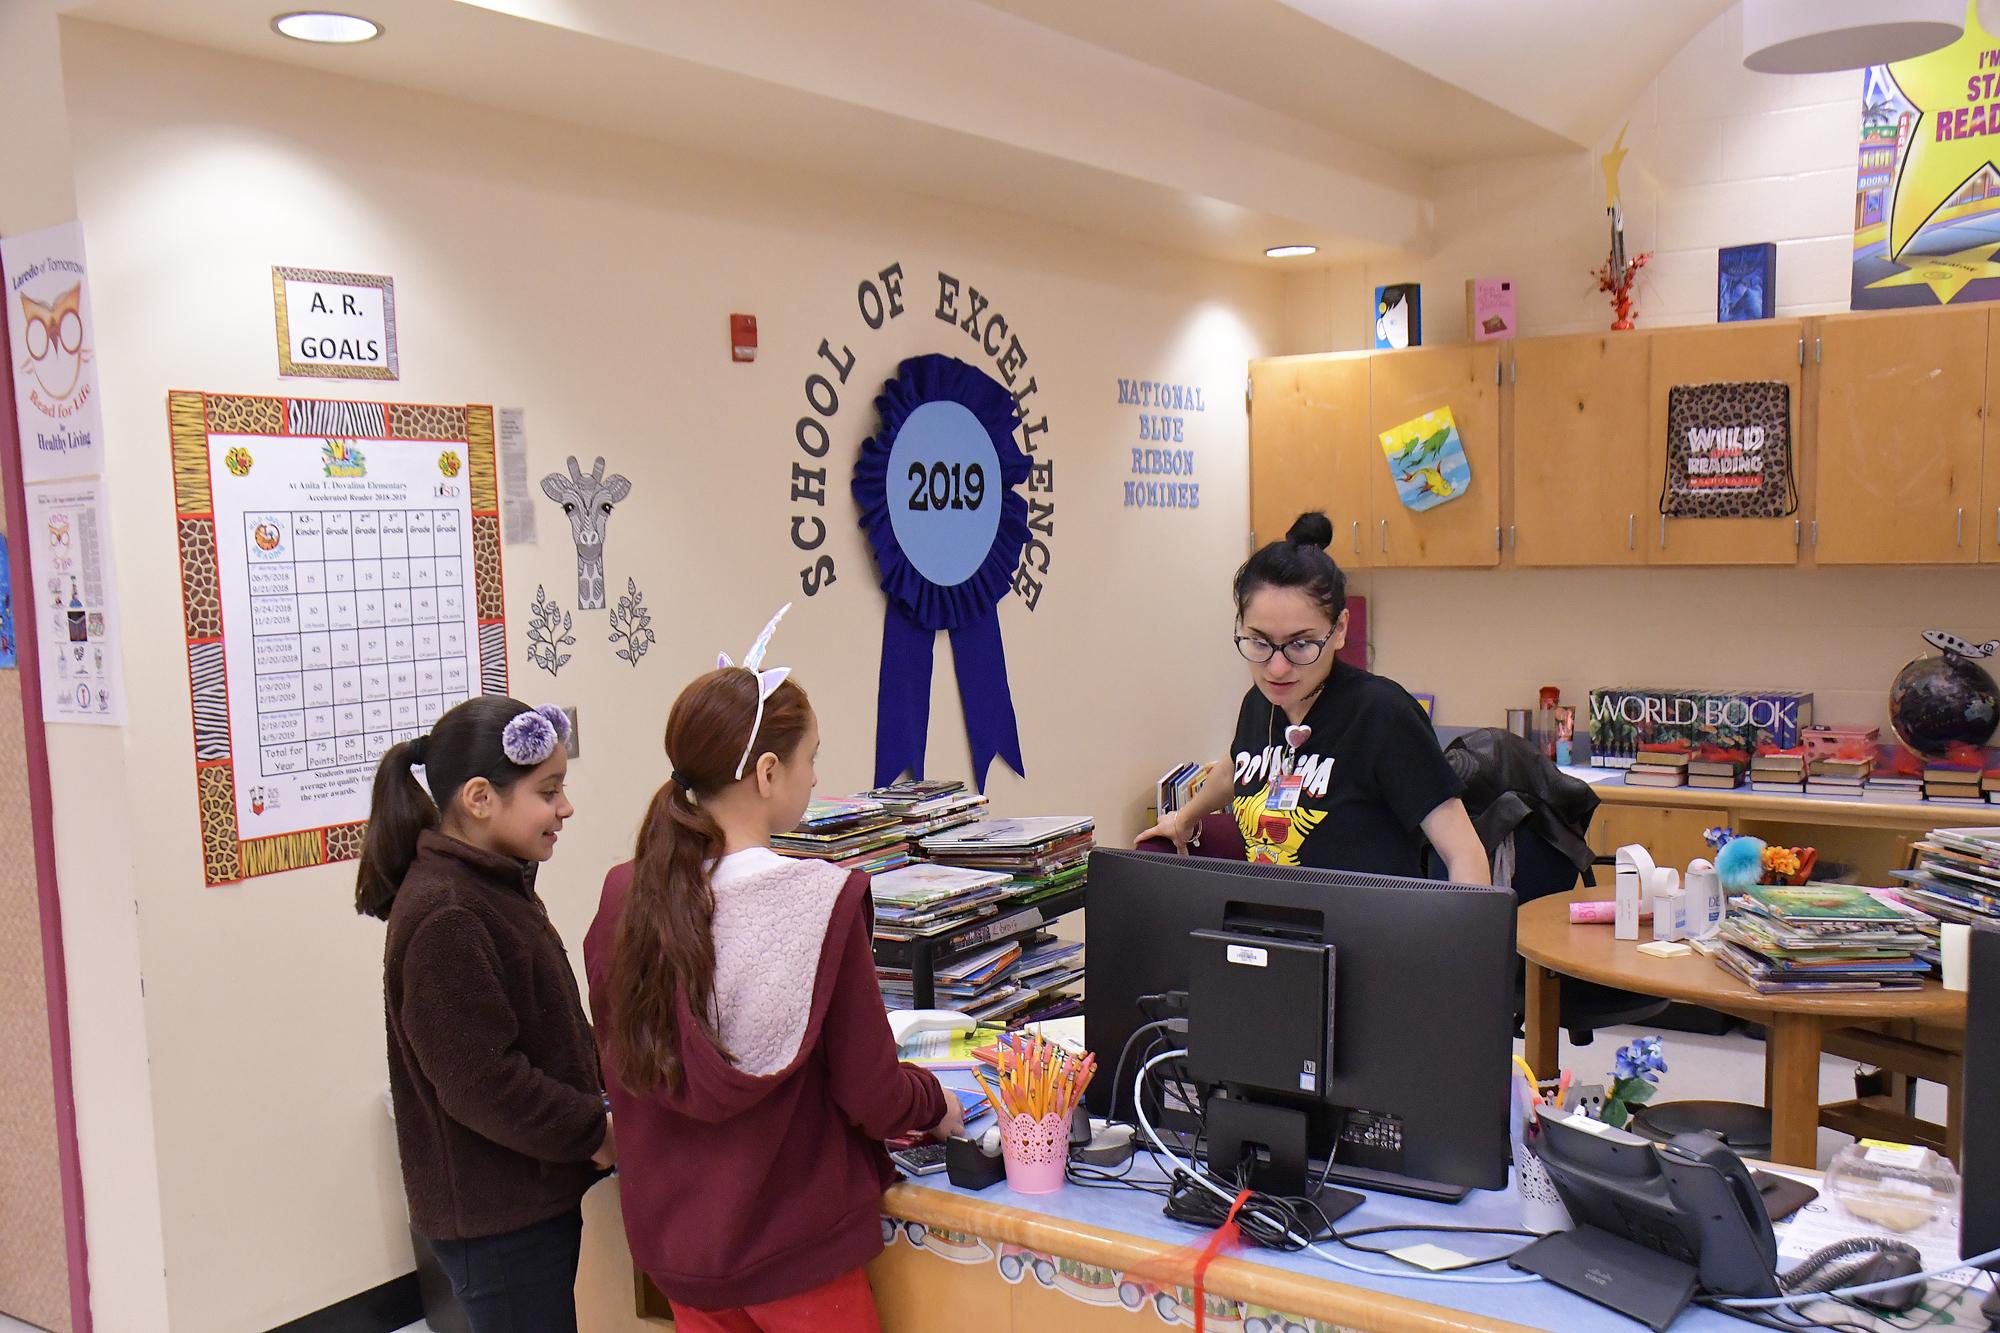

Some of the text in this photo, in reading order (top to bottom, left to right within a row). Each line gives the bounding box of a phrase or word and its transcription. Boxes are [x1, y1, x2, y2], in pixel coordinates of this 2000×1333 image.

[12, 264, 39, 290] Laredo
[300, 337, 379, 362] GOALS
[1118, 378, 1205, 412] NATIONAL
[790, 262, 1054, 612] SCHOOL OF EXCELLENCE
[1139, 414, 1184, 442] BLUE
[1688, 425, 1764, 452] WILD
[38, 430, 91, 454] Healthy Living
[1132, 448, 1194, 476] RIBBON
[1688, 455, 1763, 474] READING
[908, 461, 985, 511] 2019
[1124, 480, 1200, 508] NOMINEE
[1590, 695, 1796, 730] WORLD BOOK
[316, 742, 327, 752] 75
[344, 740, 356, 749] 85
[373, 736, 384, 744] 95
[265, 746, 302, 759] Total for
[310, 757, 334, 767] Points
[338, 752, 364, 762] Points
[274, 760, 295, 771] Year
[314, 768, 344, 779] Students
[300, 781, 328, 792] average
